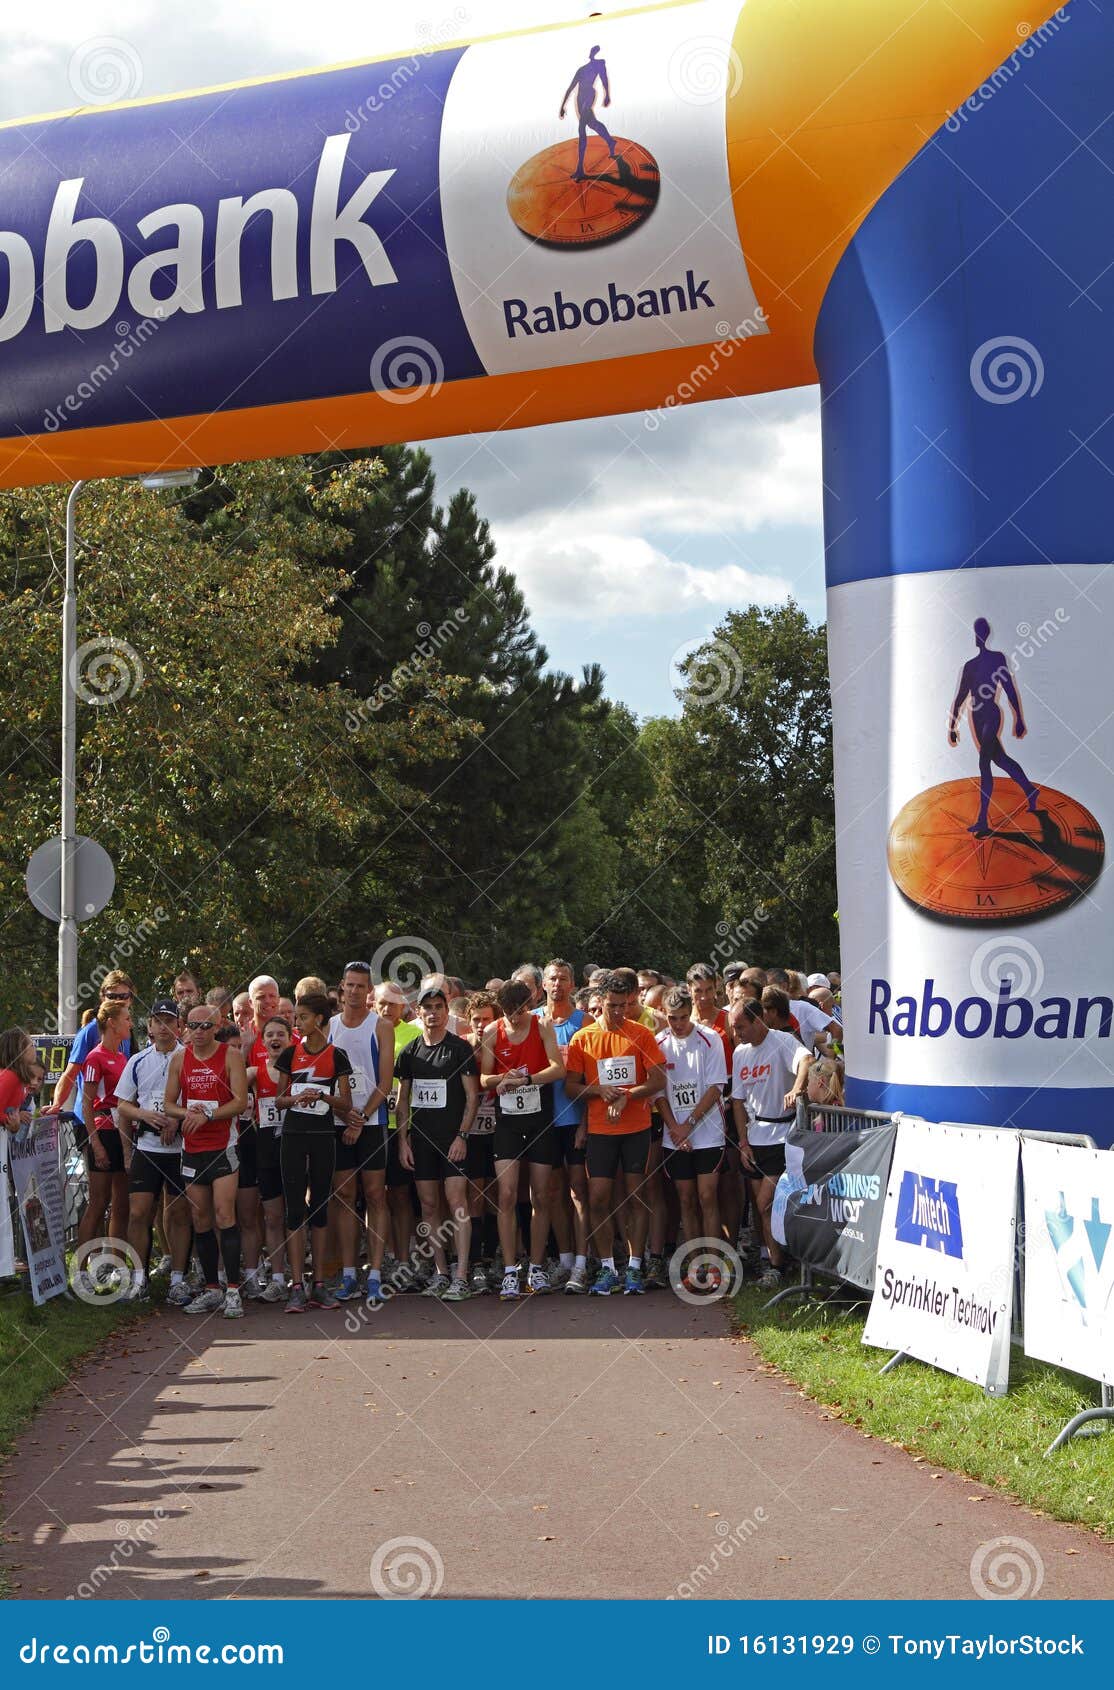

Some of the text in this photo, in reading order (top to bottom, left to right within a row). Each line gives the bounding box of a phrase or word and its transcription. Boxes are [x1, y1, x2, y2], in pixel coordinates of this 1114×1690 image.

[503, 270, 715, 338] Rabobank
[868, 978, 1114, 1039] Raboban
[187, 1075, 217, 1083] VEDETTE
[606, 1067, 629, 1080] 358
[418, 1090, 438, 1102] 414
[516, 1096, 524, 1109] 8
[675, 1090, 697, 1105] 101
[477, 1116, 492, 1130] 78
[912, 1182, 951, 1236] Imtech
[881, 1268, 950, 1318] Sprinkler
